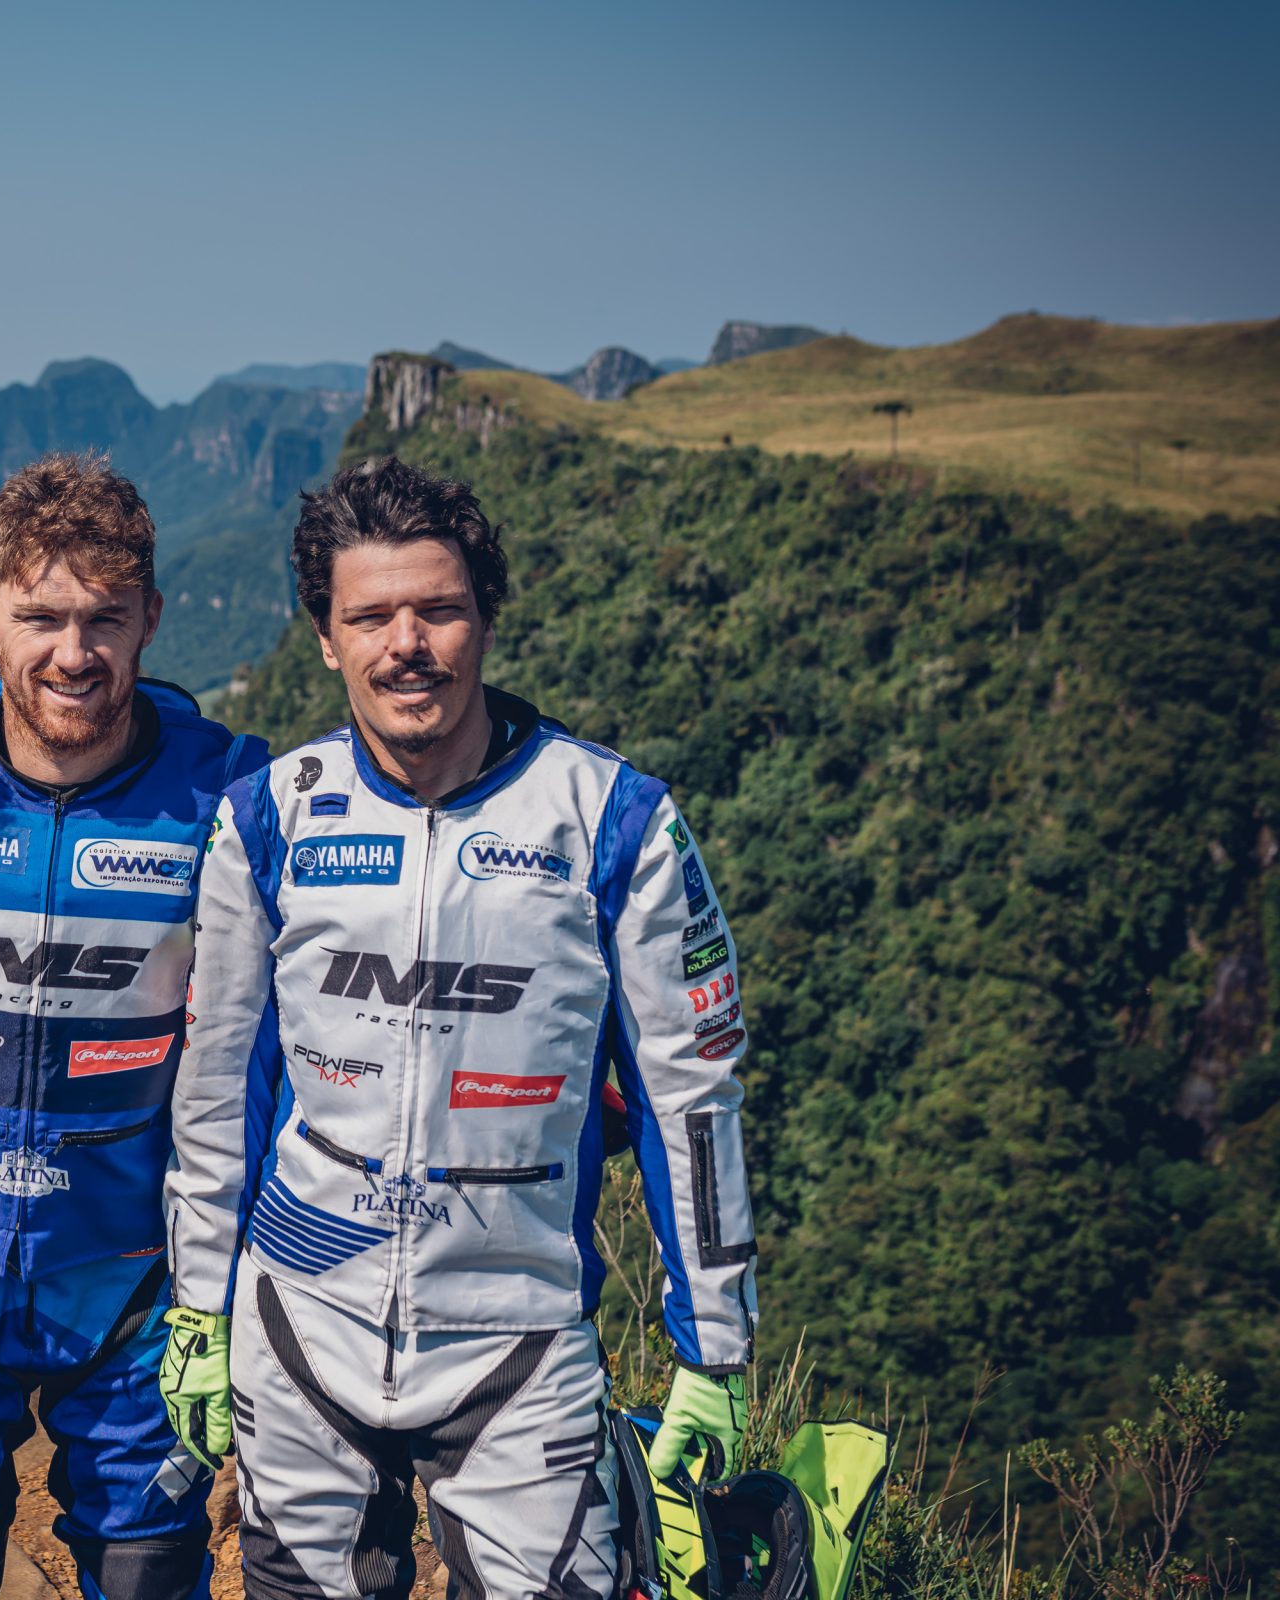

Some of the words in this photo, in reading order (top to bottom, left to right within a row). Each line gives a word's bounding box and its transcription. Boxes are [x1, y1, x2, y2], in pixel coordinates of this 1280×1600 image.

[316, 844, 395, 868] YAMAHA
[307, 868, 390, 877] RACING
[687, 947, 728, 973] DURAG
[319, 946, 536, 1014] IMS
[355, 1010, 455, 1034] racing
[74, 1048, 161, 1063] Polisport
[294, 1043, 384, 1079] POWER
[319, 1066, 361, 1089] MX
[455, 1079, 552, 1098] Polisport
[352, 1193, 453, 1228] PLATINA
[177, 1313, 202, 1326] IMS
